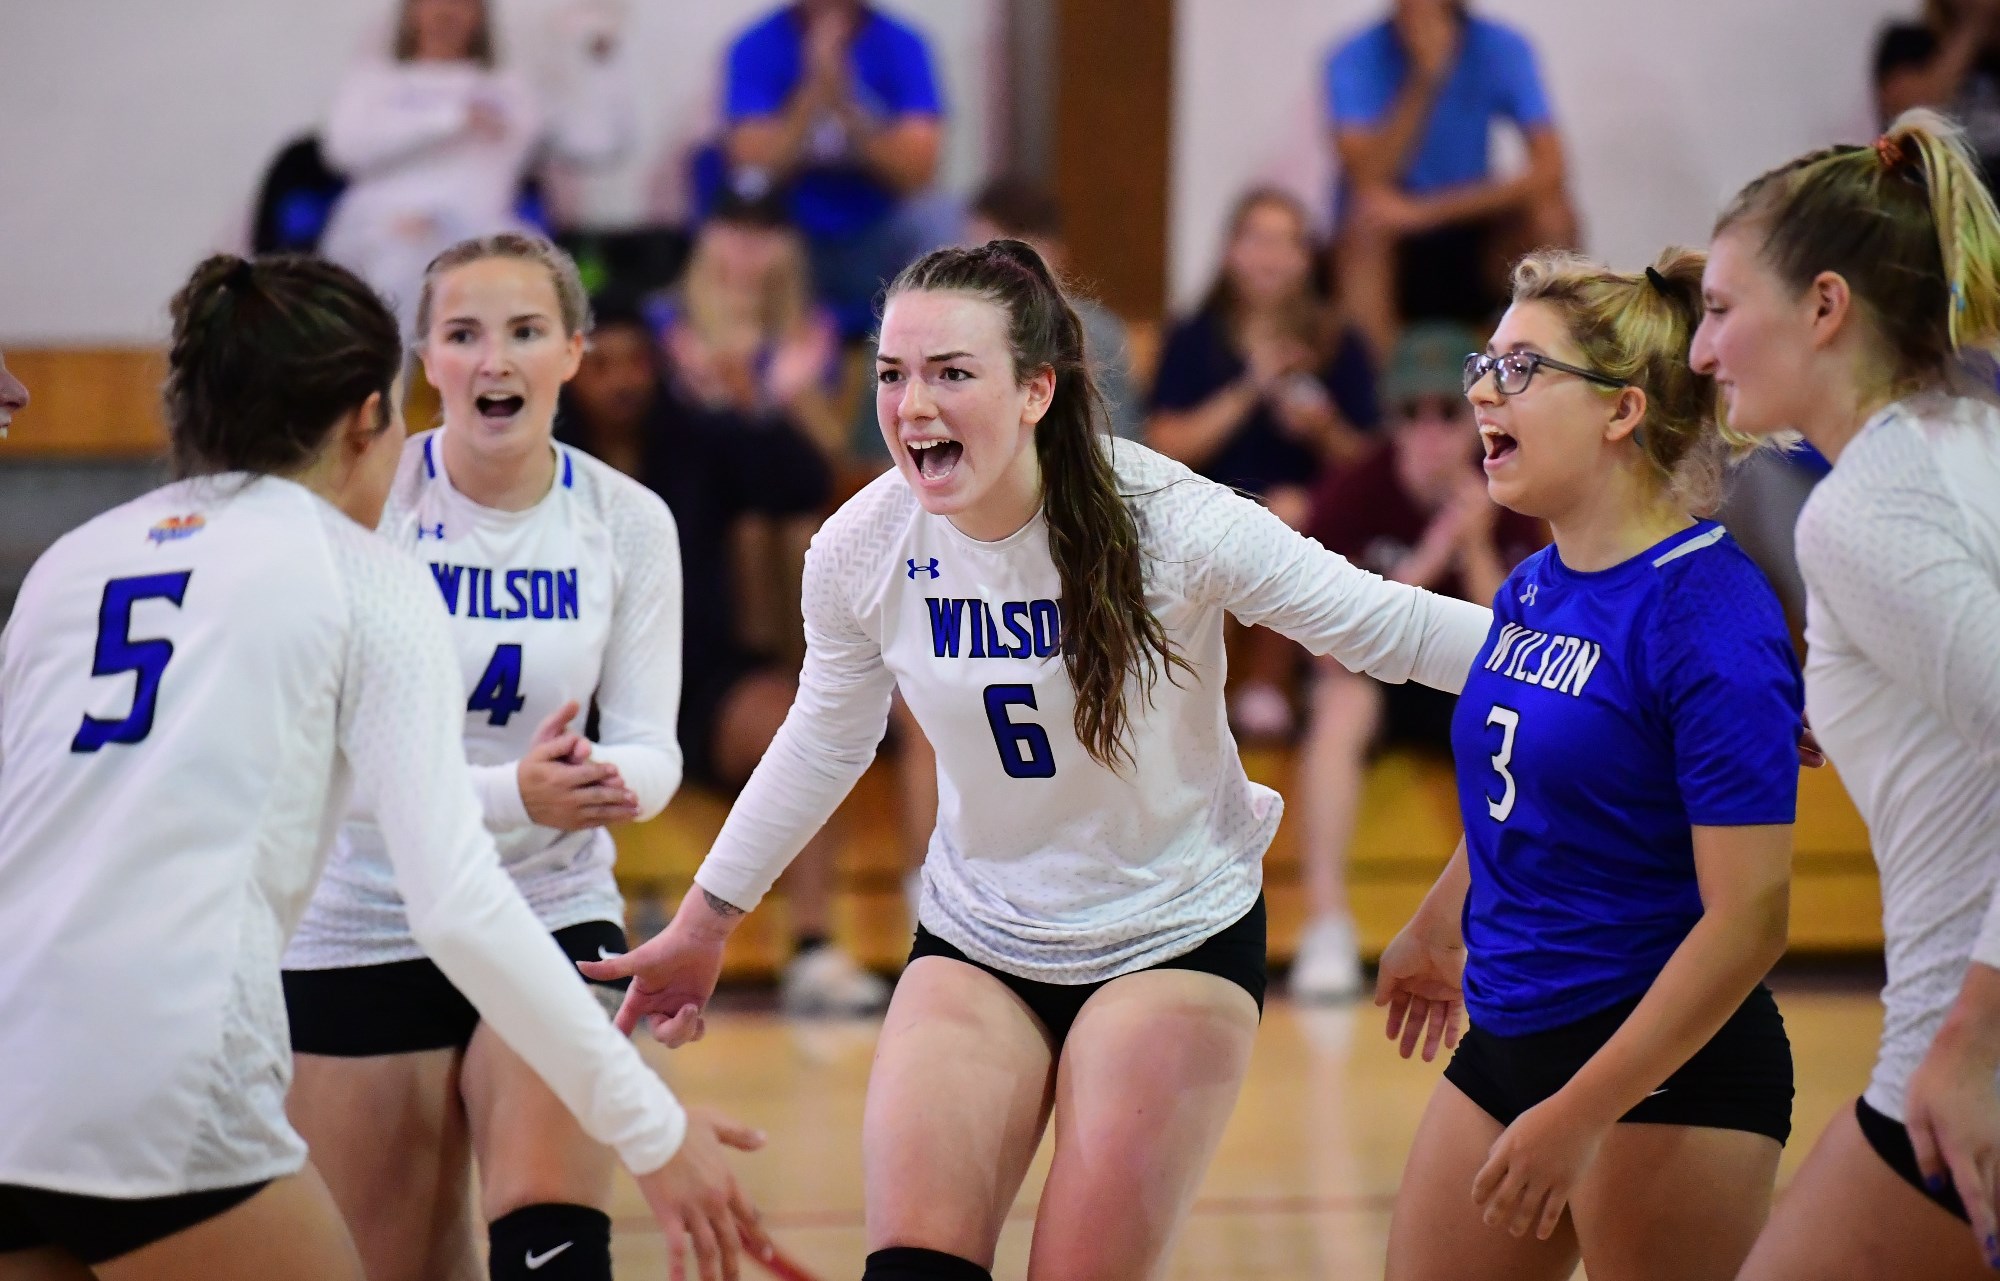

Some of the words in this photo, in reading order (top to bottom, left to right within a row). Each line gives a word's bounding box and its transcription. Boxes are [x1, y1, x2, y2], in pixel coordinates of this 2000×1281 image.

[430, 563, 577, 619] WILSON
[925, 597, 1064, 659] WILSO
[70, 570, 192, 752] 5
[467, 644, 525, 726] 4
[1484, 621, 1601, 697] WILSON
[983, 684, 1056, 779] 6
[1485, 704, 1520, 823] 3
